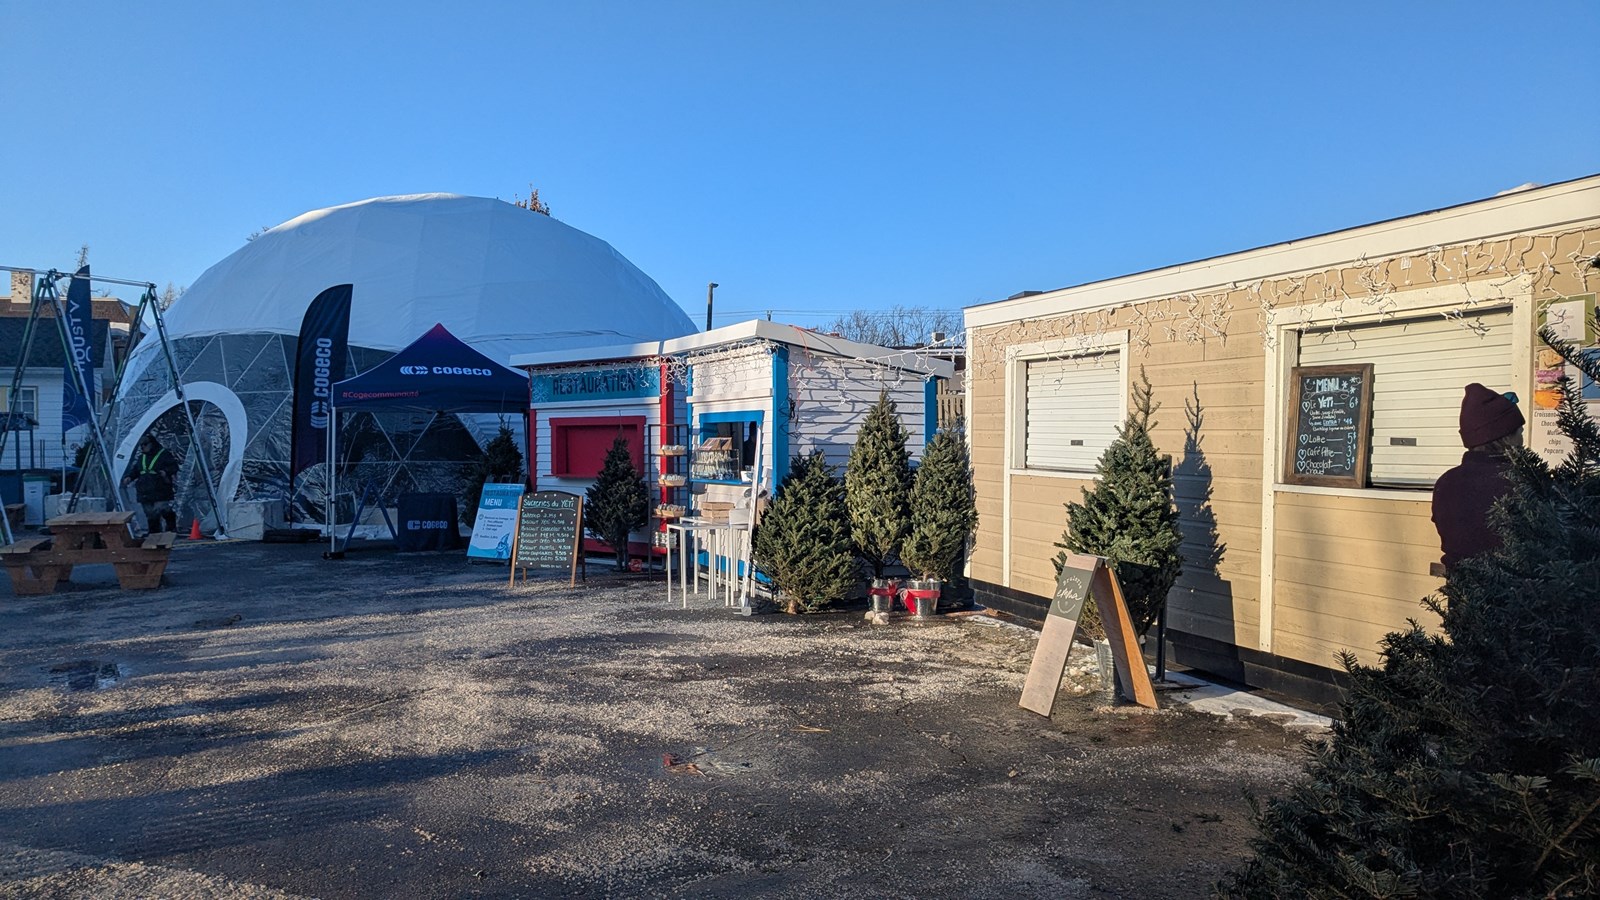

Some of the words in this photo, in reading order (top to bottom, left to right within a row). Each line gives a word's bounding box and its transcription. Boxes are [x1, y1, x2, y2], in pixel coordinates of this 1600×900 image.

[552, 374, 636, 395] RESTAURATION
[1316, 378, 1339, 393] MENU
[1306, 459, 1332, 469] Chocolat
[484, 498, 503, 507] MENU
